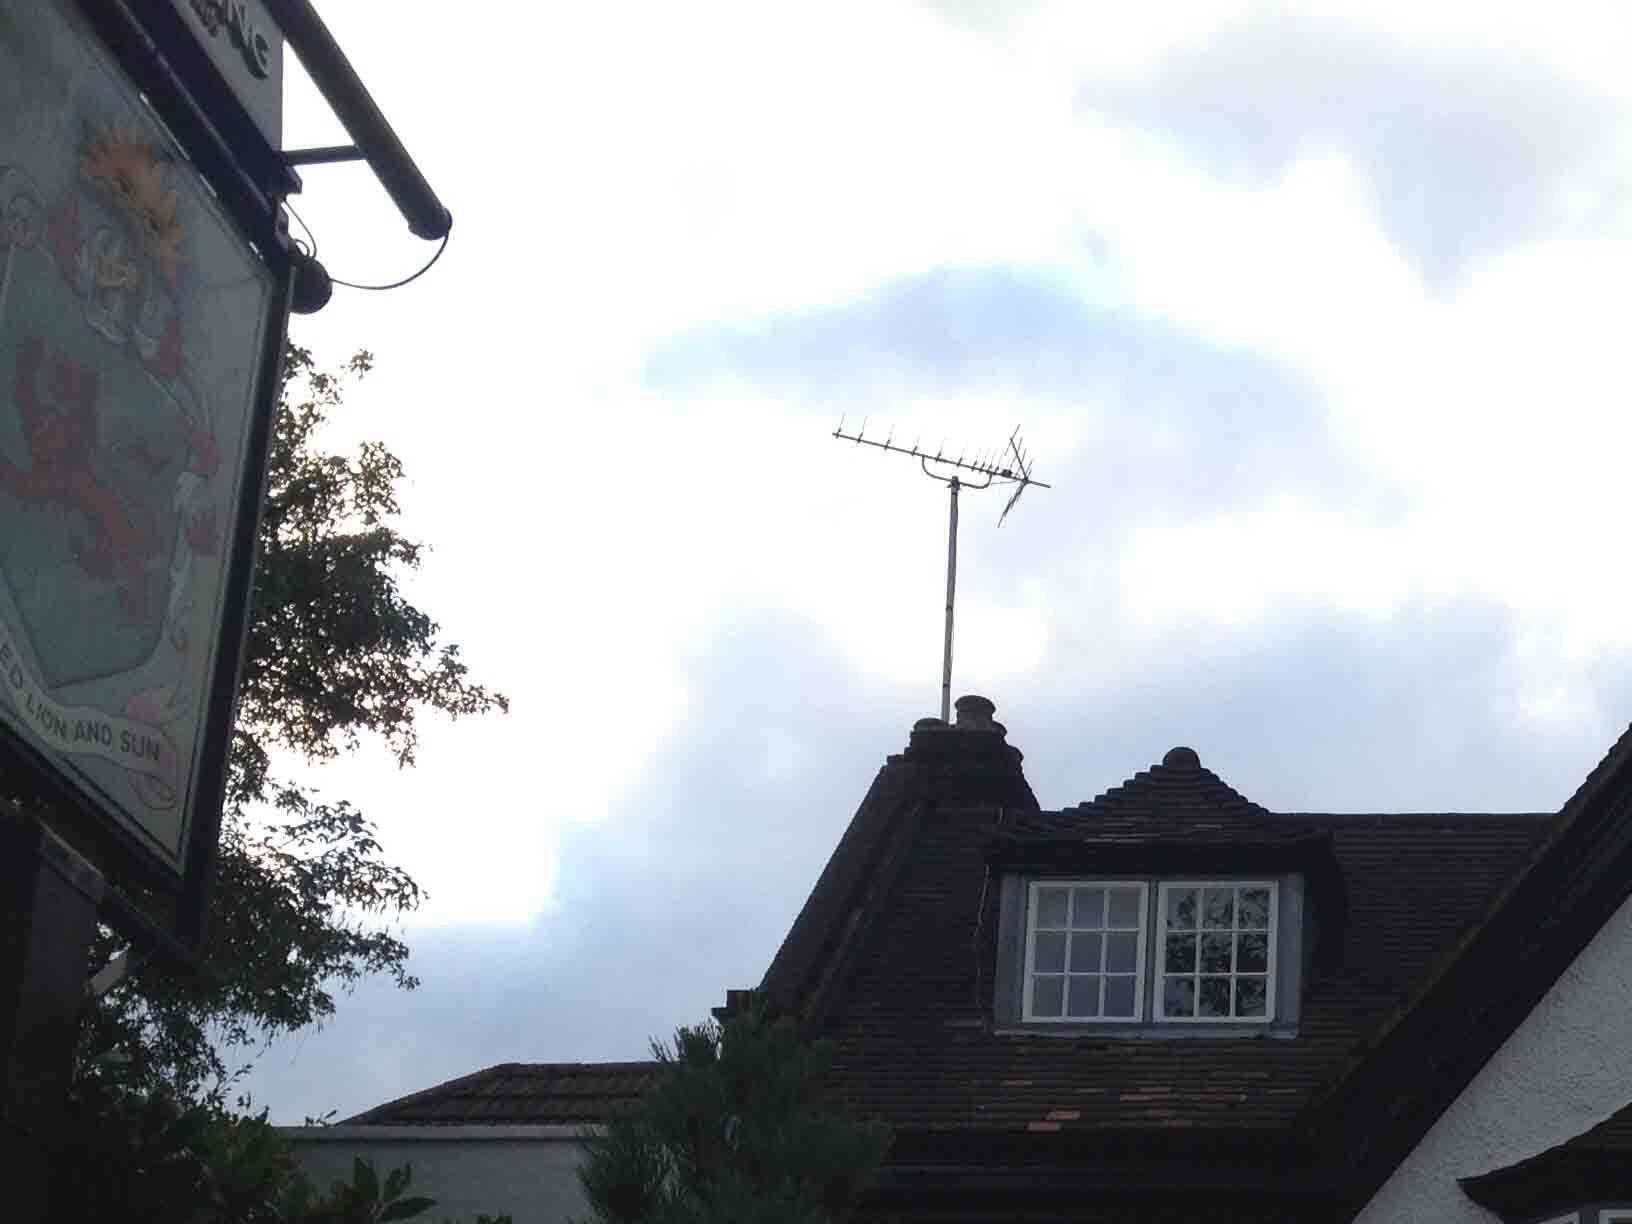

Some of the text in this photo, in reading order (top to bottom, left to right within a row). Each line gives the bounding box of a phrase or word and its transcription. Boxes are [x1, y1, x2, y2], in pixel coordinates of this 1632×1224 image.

[25, 692, 66, 738] LION
[74, 719, 112, 745] AND
[120, 729, 159, 760] SUN
